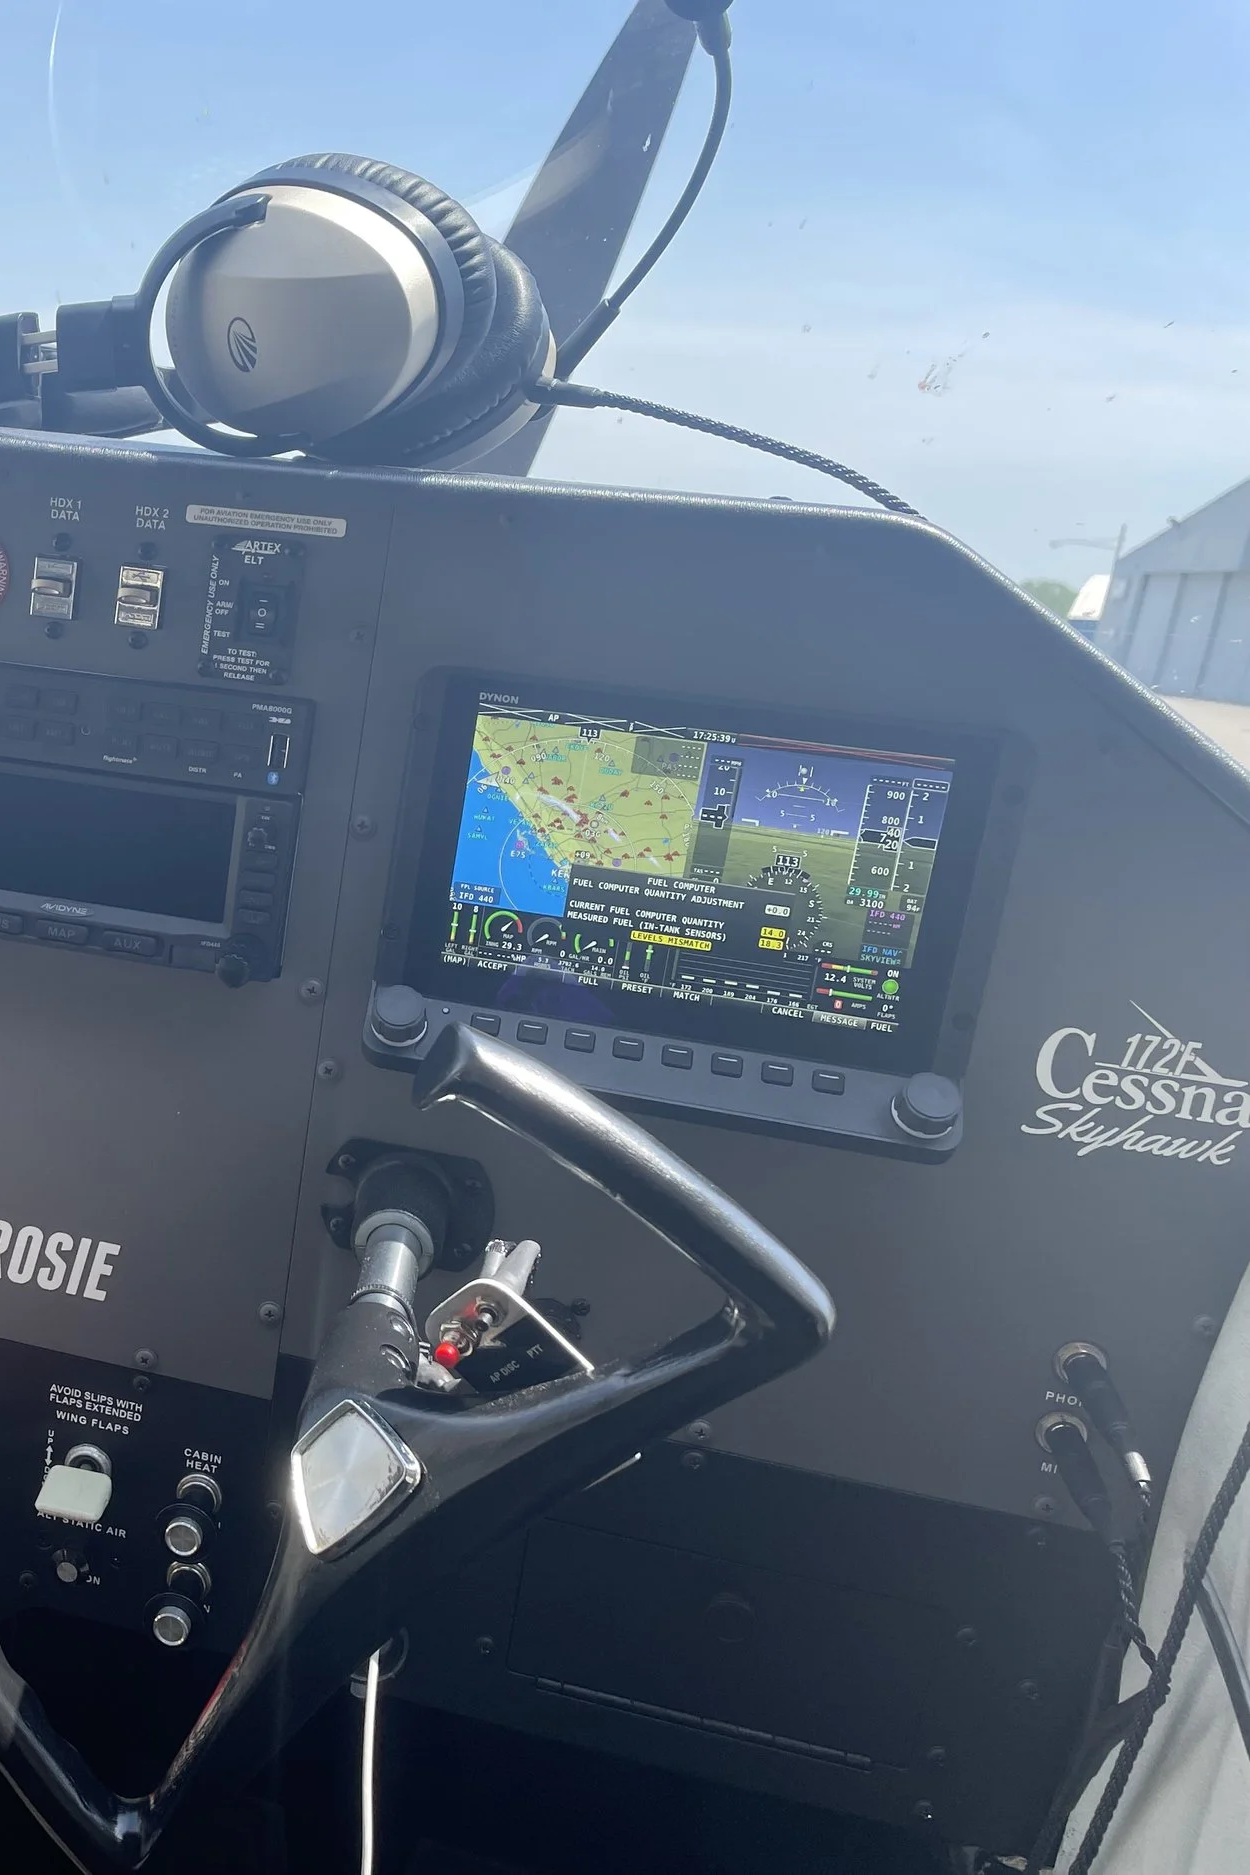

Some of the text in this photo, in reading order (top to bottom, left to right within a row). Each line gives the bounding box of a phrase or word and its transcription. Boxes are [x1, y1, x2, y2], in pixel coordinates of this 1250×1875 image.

[50, 497, 82, 510] HDX 1
[51, 509, 80, 521] DATA
[135, 506, 170, 519] HDX 2
[136, 518, 166, 530] DATA
[245, 540, 282, 553] ARTEX
[244, 556, 264, 565] ELT
[201, 555, 220, 655] EMERGENCY USE ONLY
[479, 692, 519, 704] DYNON
[886, 791, 906, 801] 900
[777, 857, 799, 867] 113
[647, 877, 716, 894] FUEL COMPUTER
[573, 878, 745, 909] FUEL COMPUTER QUANTITY ADJUSTMENT
[40, 902, 87, 916] AVIDYNE
[569, 900, 725, 930] CURRENT FUEL COMPUTER QUANTITY
[766, 906, 789, 916] +0.0
[47, 926, 76, 940] MAP
[567, 911, 727, 942] MEASURED FUEL (IN-TANK SENSORS)
[762, 928, 785, 938] 14.0
[113, 937, 142, 950] AUX
[631, 932, 710, 950] LEVELS MISMATCH
[760, 939, 782, 950] 18.3
[477, 960, 508, 971] ACCEPT
[578, 976, 598, 986] FULL
[824, 972, 847, 983] 12.4
[622, 982, 653, 994] PRESET
[673, 991, 700, 1001] MATCH
[772, 1007, 804, 1019] CANCEL
[820, 1014, 858, 1027] MESSAGE
[870, 1023, 892, 1033] FUEL
[1035, 1027, 1250, 1128] Cessna
[1020, 1102, 1243, 1165] Skyhawk
[50, 1383, 143, 1412] AVOID SLIPS WITH
[50, 1393, 141, 1422] FLAPS EXTENDED
[56, 1410, 130, 1435] WING FLAPS
[184, 1448, 222, 1464] CABIN
[186, 1459, 217, 1474] HEAT
[62, 1516, 126, 1539] STATIC AIR
